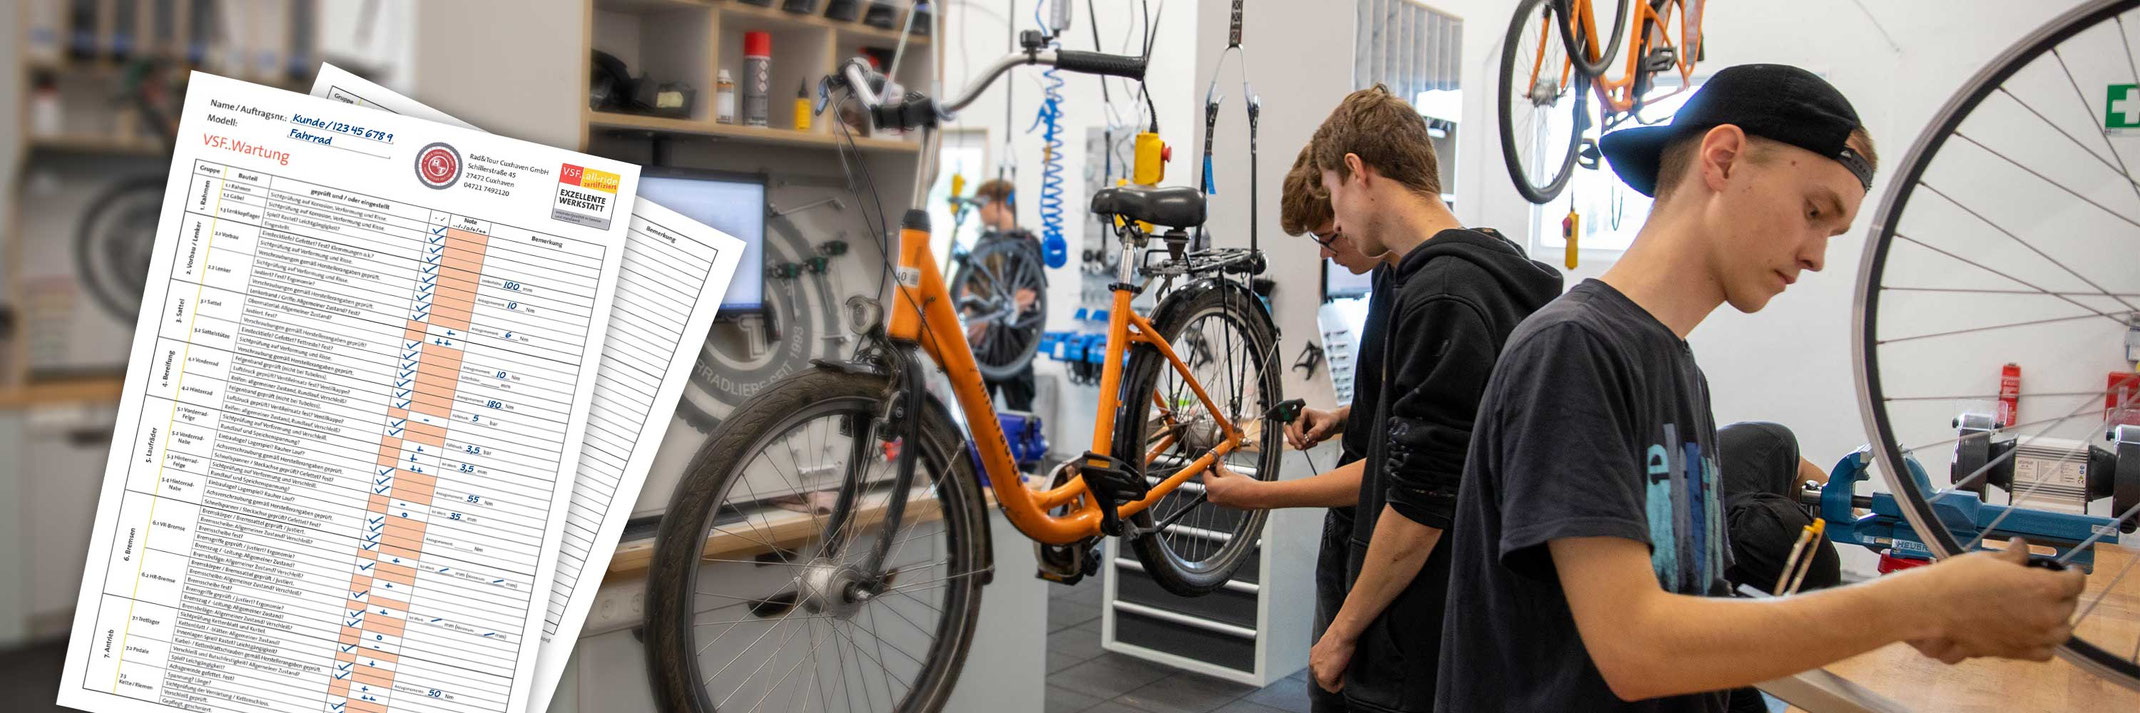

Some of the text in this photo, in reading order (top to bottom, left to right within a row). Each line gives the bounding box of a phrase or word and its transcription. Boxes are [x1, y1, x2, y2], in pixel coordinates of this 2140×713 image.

[210, 98, 234, 110] Name
[239, 105, 287, 122] Auftragsnr.:
[206, 113, 237, 126] Modell:
[289, 128, 332, 144] Fahrrad
[199, 164, 220, 174] Gruppe
[467, 162, 507, 176] Schillerstraße
[469, 153, 549, 175] Rad&Tour Cuxhaven GmbH
[238, 172, 258, 181] Bauteil
[465, 172, 514, 187] 27472 Cuxhaven
[199, 180, 210, 205] Rahmen
[463, 181, 509, 196] 04721 7492120
[559, 188, 606, 204] EXZELLENTE
[310, 189, 331, 197] geprüft
[360, 199, 390, 210] eingestellt
[558, 196, 604, 212] WERKSTATT
[531, 235, 563, 248] Bemerkung
[645, 225, 677, 244] Bemerkung
[186, 246, 196, 268] Vorbau
[192, 220, 201, 242] Lenker
[503, 280, 520, 291] 100
[176, 298, 184, 317] Sattel
[162, 350, 175, 380] Bereifung
[496, 371, 506, 379] 10
[486, 400, 502, 408] 180
[145, 427, 157, 456] Laufräder
[467, 445, 480, 455] 3,5
[459, 463, 474, 472] 3,5
[450, 512, 461, 520] 35
[124, 527, 135, 554] Bremsen
[104, 629, 114, 652] Antrieb
[428, 688, 441, 698] 50
